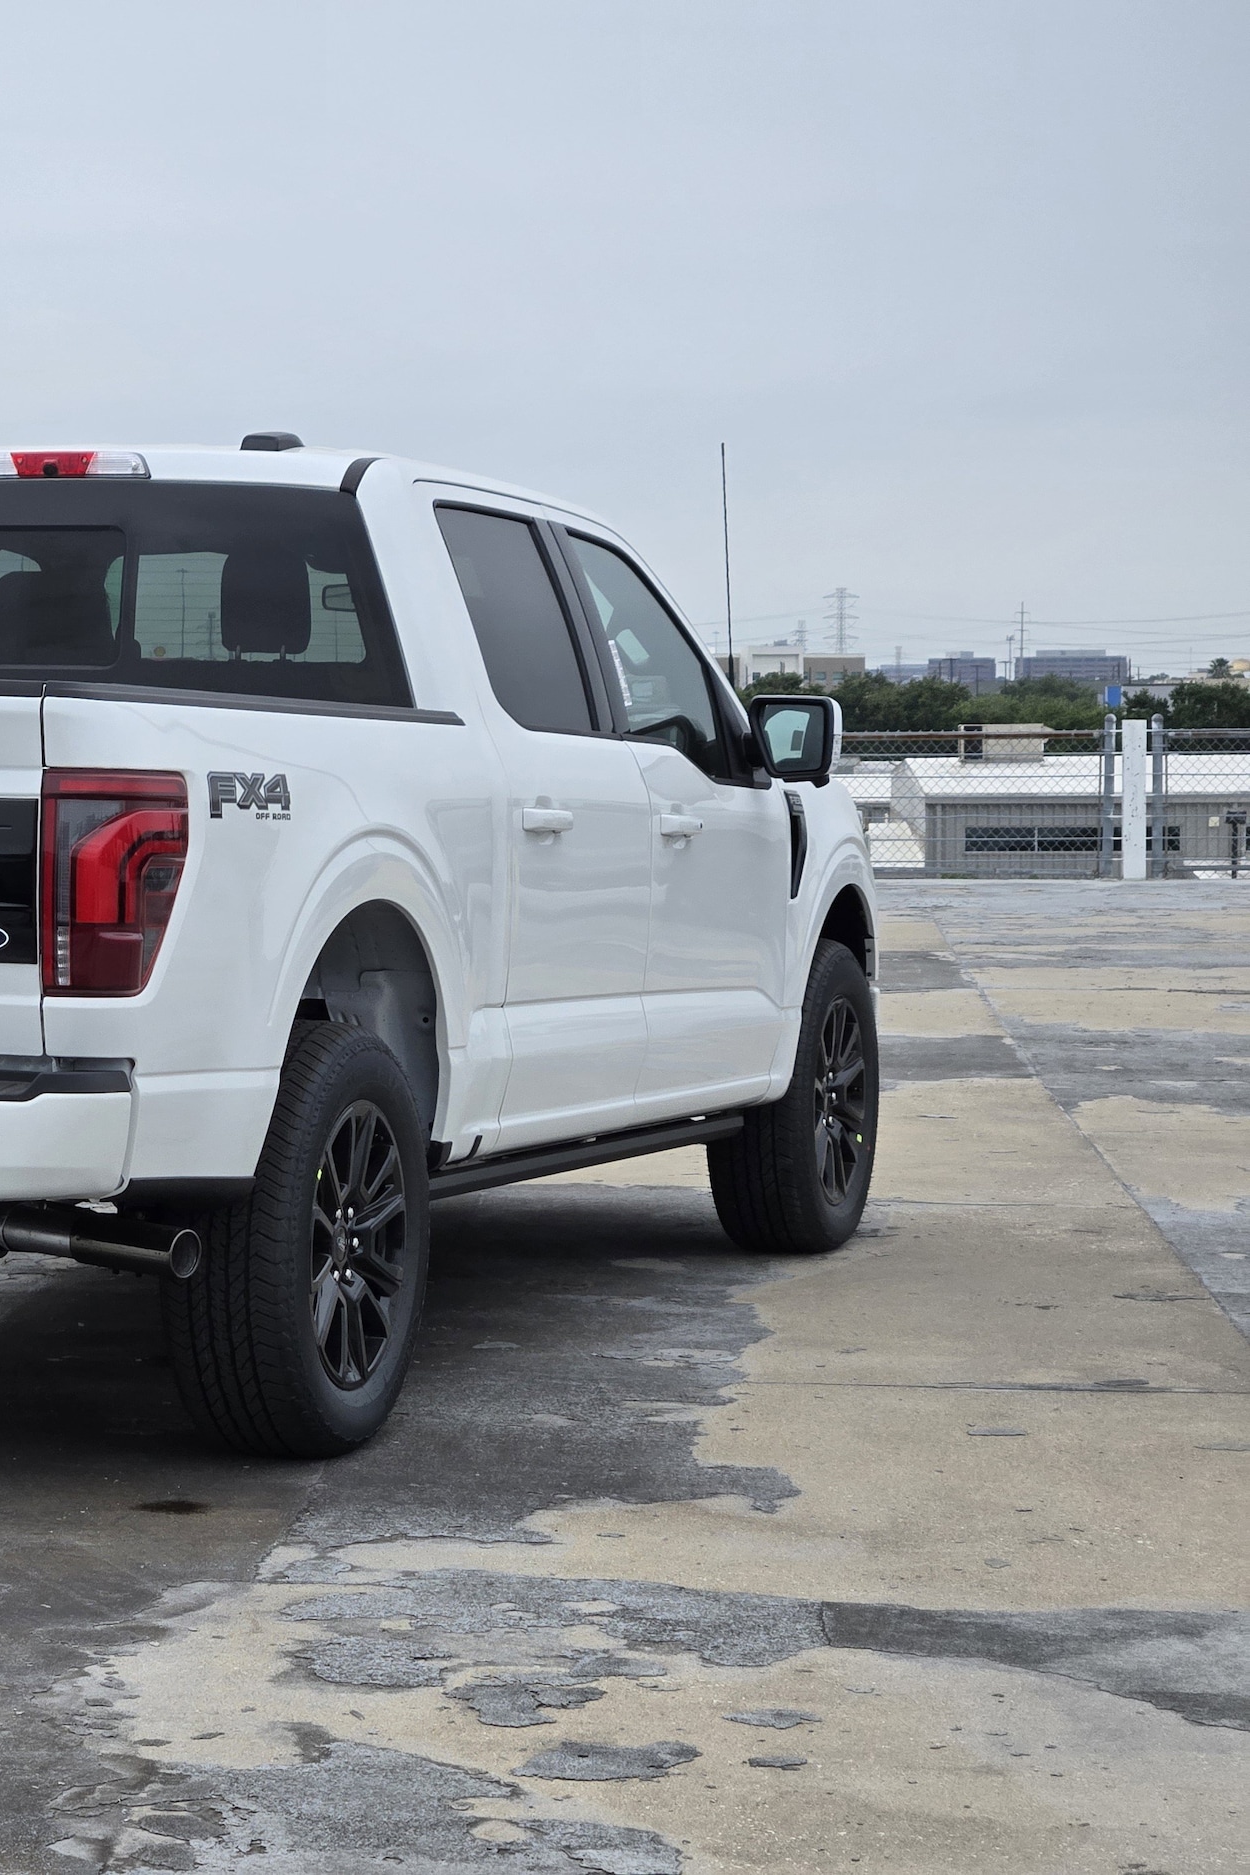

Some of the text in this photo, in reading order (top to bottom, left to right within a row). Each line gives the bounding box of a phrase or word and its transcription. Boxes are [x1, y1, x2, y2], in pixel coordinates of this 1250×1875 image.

[206, 770, 291, 819] FX4
[256, 812, 292, 821] OFF ROAD
